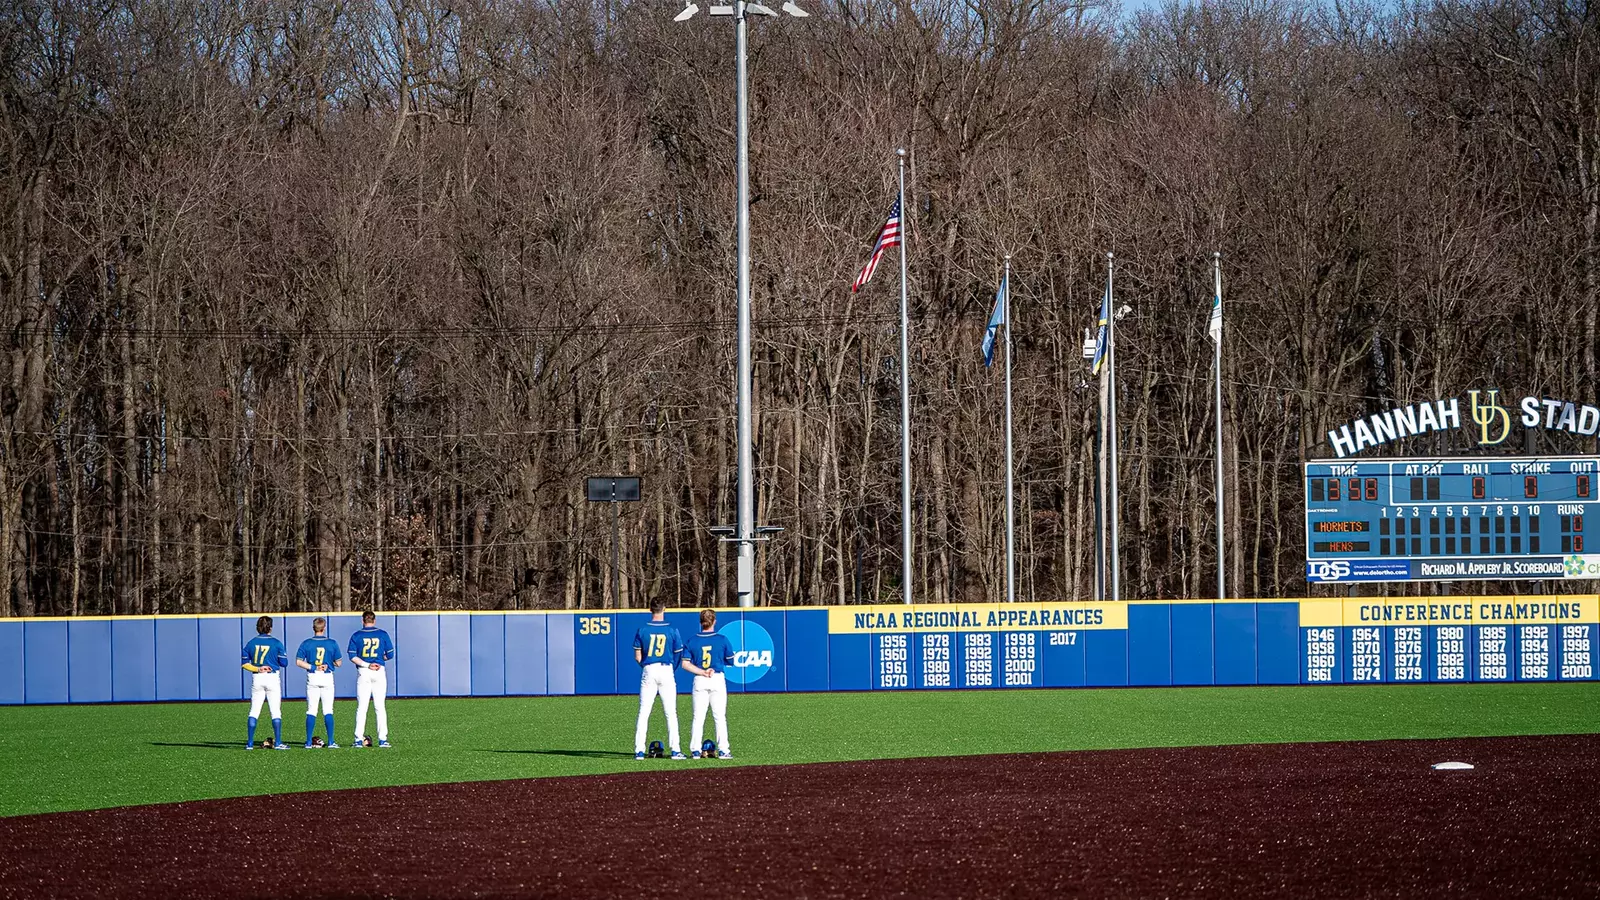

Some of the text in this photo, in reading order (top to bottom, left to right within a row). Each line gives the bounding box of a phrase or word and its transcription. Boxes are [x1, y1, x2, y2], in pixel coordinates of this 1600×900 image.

[1521, 396, 1600, 437] STAD
[1329, 399, 1460, 457] HANNAH
[1330, 465, 1358, 477] TIME
[1406, 465, 1419, 476] AT
[1463, 464, 1490, 475] BALL
[1510, 463, 1551, 474] STRIKE
[1570, 462, 1593, 474] OUT
[1329, 479, 1378, 500] 3:58
[1473, 477, 1485, 498] 0
[1525, 475, 1537, 497] 0
[1577, 475, 1589, 497] 0
[1381, 504, 1584, 517] 1 2 3 4 5 6 7 8 9 10 RUNS
[1320, 521, 1362, 532] HORNETS
[1330, 542, 1353, 552] HENS
[1421, 562, 1456, 575] RICHARD
[1457, 562, 1468, 574] M.
[1468, 562, 1501, 574] APPLEBY
[1514, 561, 1564, 574] SCOREBOARD
[1360, 603, 1580, 621] CONFERENCE CHAMPIONS
[854, 609, 1103, 628] NCAA REGIONAL APPEARANCES
[579, 616, 611, 635] 365
[1306, 628, 1334, 640] 1946
[1352, 628, 1380, 640] 1964
[1394, 628, 1421, 640] 1975
[1437, 628, 1464, 640] 1980
[1480, 627, 1506, 639] 1985
[1520, 626, 1548, 638] 1992
[1562, 626, 1590, 638] 1997
[880, 635, 907, 647] 1956
[922, 634, 950, 646] 1978
[965, 634, 992, 646] 1983
[1005, 634, 1035, 646] 1998
[1050, 632, 1077, 645] 2017
[362, 638, 380, 657] 22
[647, 634, 667, 657] 19
[1306, 642, 1334, 654] 1958
[1352, 642, 1380, 654] 1970
[1394, 641, 1421, 653] 1976
[1437, 641, 1464, 653] 1981
[1480, 640, 1506, 652] 1987
[1520, 640, 1548, 652] 1994
[1562, 639, 1590, 651] 1998
[254, 645, 270, 664] 17
[315, 647, 325, 666] 9
[702, 646, 712, 668] 5
[733, 650, 772, 667] CAA
[880, 648, 907, 660] 1960
[922, 648, 950, 660] 1979
[965, 647, 992, 659] 1992
[1005, 647, 1035, 659] 1999
[1480, 653, 1506, 665] 1989
[1520, 653, 1548, 665] 1995
[1562, 652, 1590, 664] 1999
[965, 660, 992, 672] 1995
[1005, 660, 1035, 672] 2000
[1307, 655, 1335, 667] 1960
[1352, 655, 1380, 667] 1973
[1394, 654, 1421, 666] 1977
[1437, 654, 1464, 666] 1982
[880, 661, 907, 673] 1961
[922, 661, 950, 673] 1980
[1394, 667, 1421, 679] 1979
[1437, 667, 1464, 679] 1983
[1480, 666, 1506, 678] 1990
[1520, 666, 1548, 678] 1996
[1562, 665, 1592, 677] 2000
[922, 674, 950, 686] 1982
[965, 674, 992, 686] 1996
[1006, 673, 1032, 685] 2001
[1307, 668, 1332, 680] 1961
[1352, 668, 1380, 680] 1974
[880, 675, 907, 687] 1970
